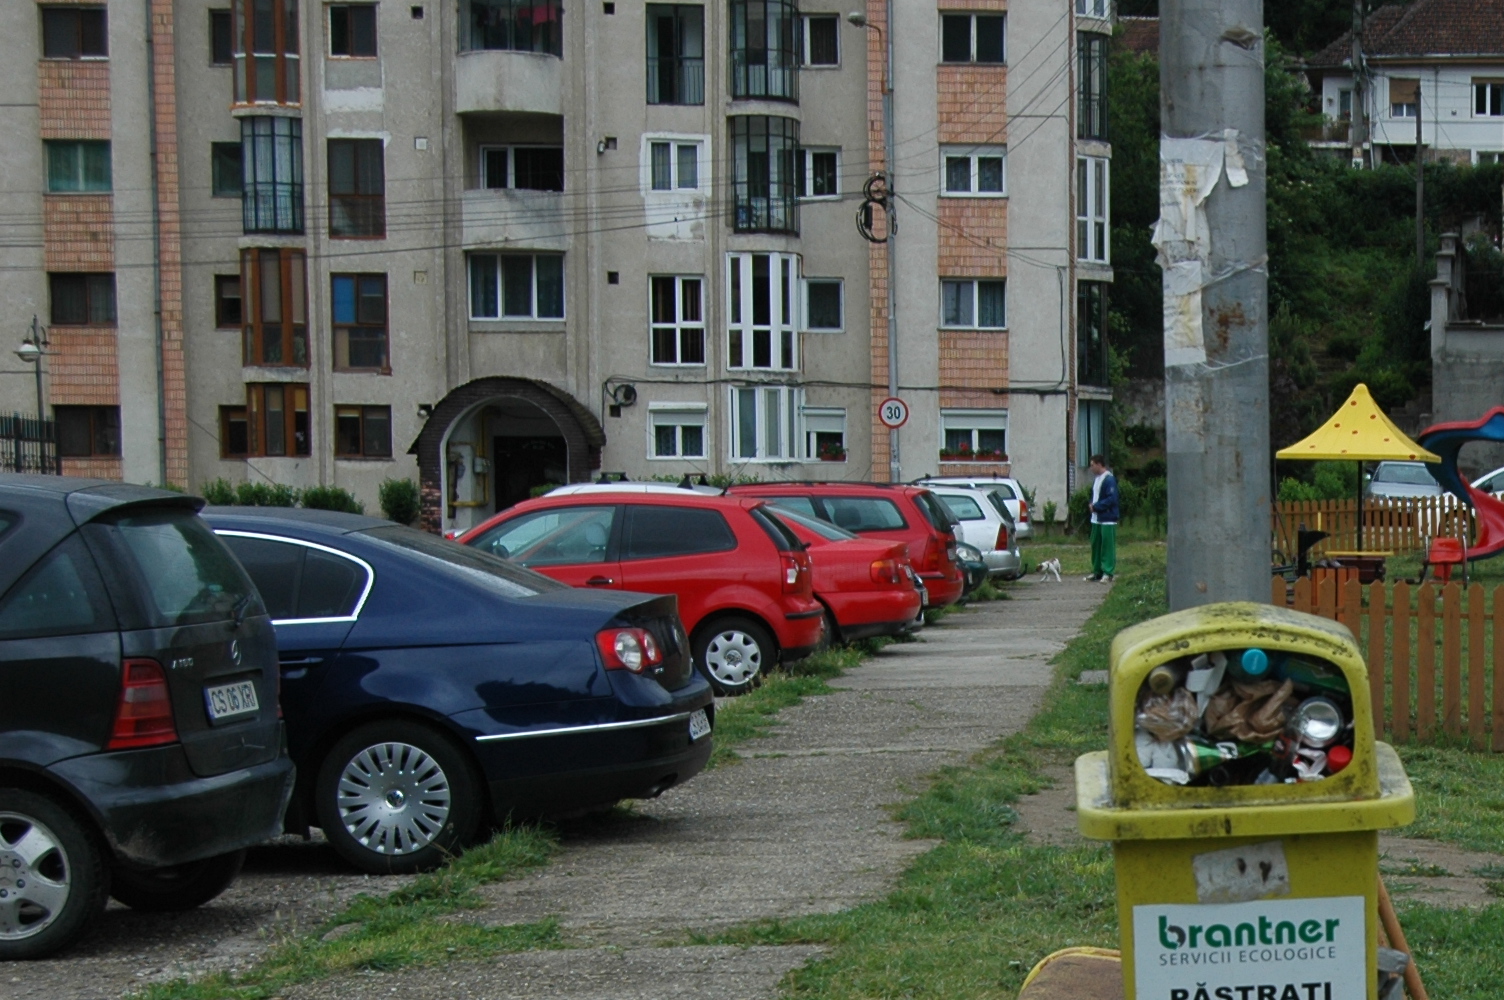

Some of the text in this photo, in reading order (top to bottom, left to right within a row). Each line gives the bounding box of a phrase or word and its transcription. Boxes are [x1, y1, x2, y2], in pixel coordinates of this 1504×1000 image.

[886, 405, 901, 420] 30
[211, 689, 228, 715] CS
[1157, 915, 1341, 950] brantner
[1159, 946, 1337, 967] SERVICII ECOLOGICE
